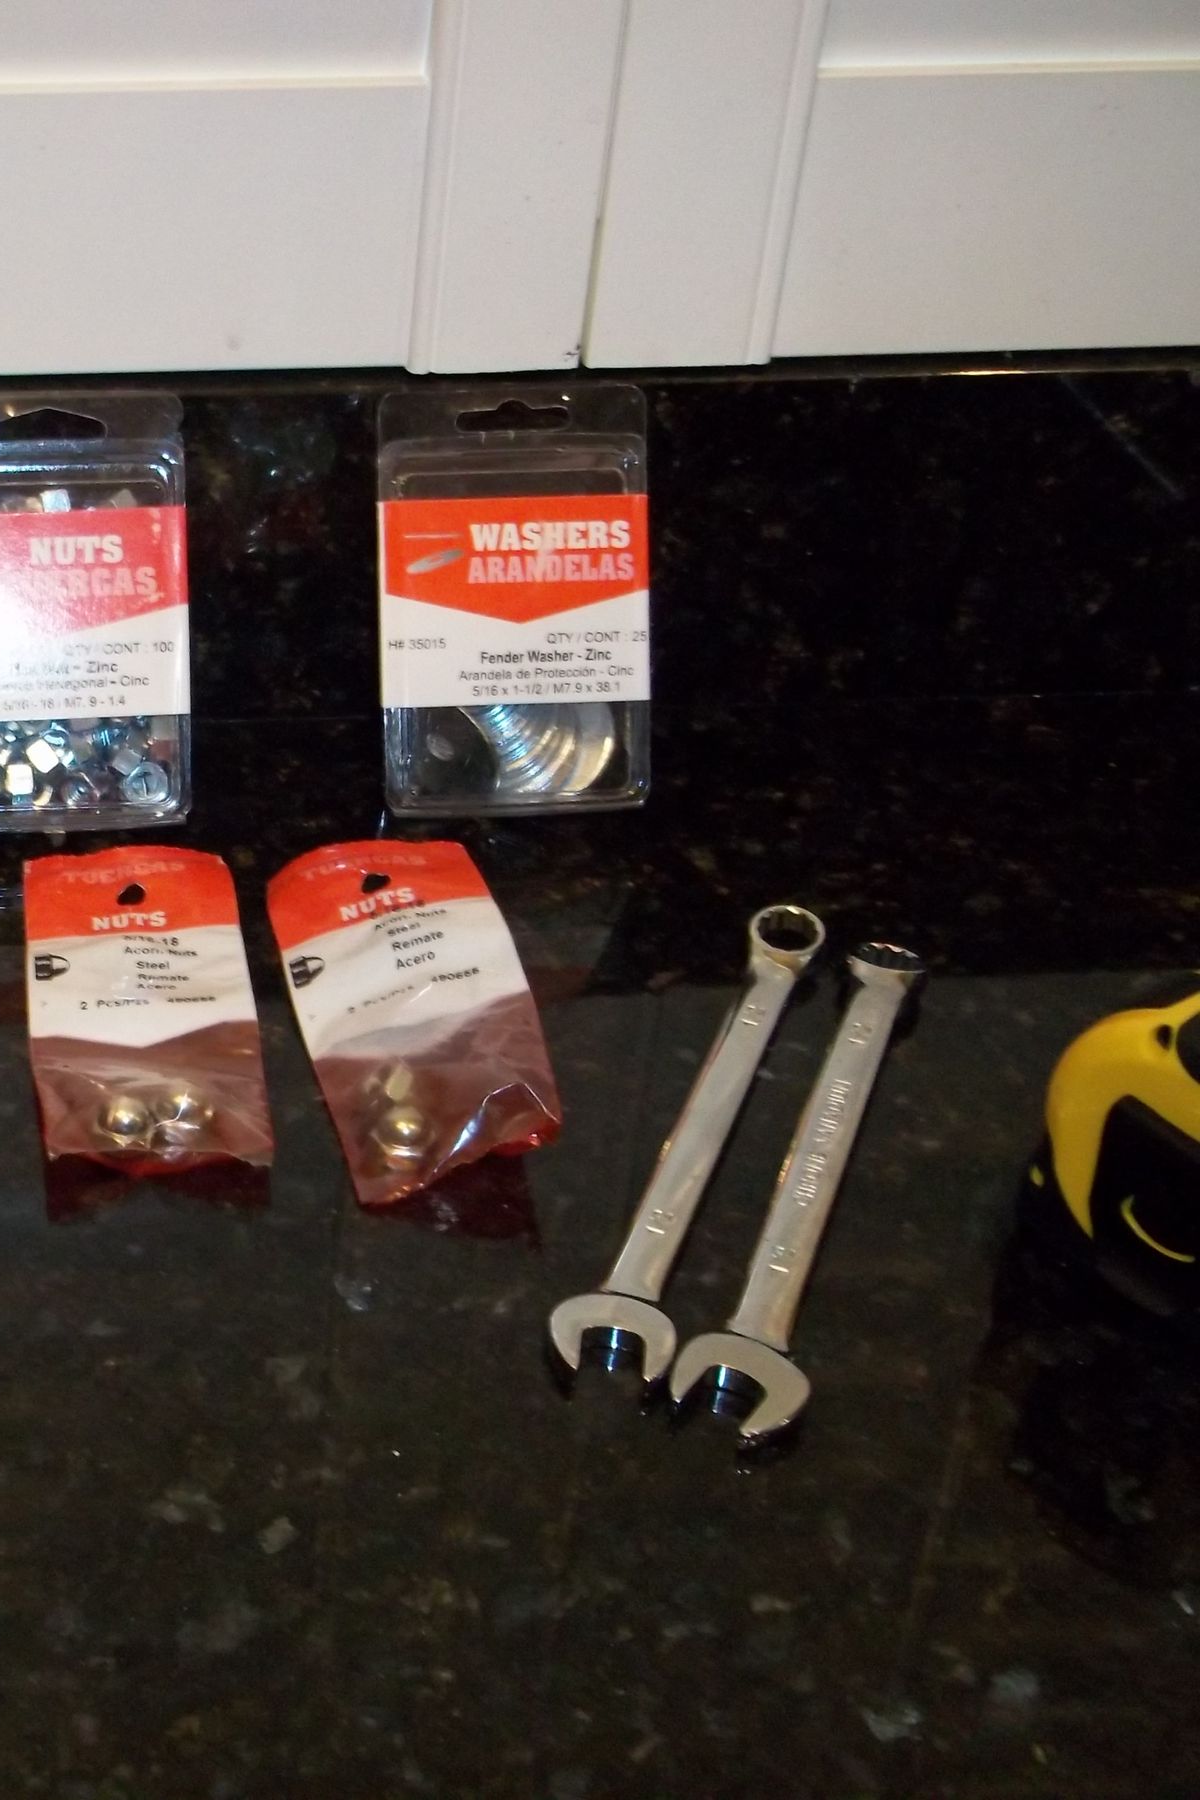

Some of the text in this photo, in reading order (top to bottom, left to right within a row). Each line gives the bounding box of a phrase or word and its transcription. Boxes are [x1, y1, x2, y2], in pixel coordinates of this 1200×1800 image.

[469, 520, 631, 552] WASHERS
[28, 534, 124, 567] NUTS
[467, 554, 635, 584] ARANDELAS
[408, 638, 447, 650] 35015
[546, 632, 573, 645] QTY
[584, 630, 621, 643] CONT
[152, 640, 175, 653] 100
[480, 651, 525, 665] Fender
[527, 650, 574, 663] Washer
[585, 648, 613, 661] Zinc
[86, 660, 119, 674] Zinc
[458, 669, 513, 681] Arandela
[516, 668, 531, 679] de
[607, 664, 635, 677] Cinc
[119, 674, 151, 688] Cinc
[472, 684, 498, 697] 5/16
[513, 683, 542, 696] 1-1/2
[338, 887, 417, 922] NUTS
[91, 910, 167, 931] NUTS
[392, 930, 444, 952] Remate
[136, 960, 170, 970] Steel
[396, 950, 436, 971] Acero
[80, 1000, 88, 1011] 2
